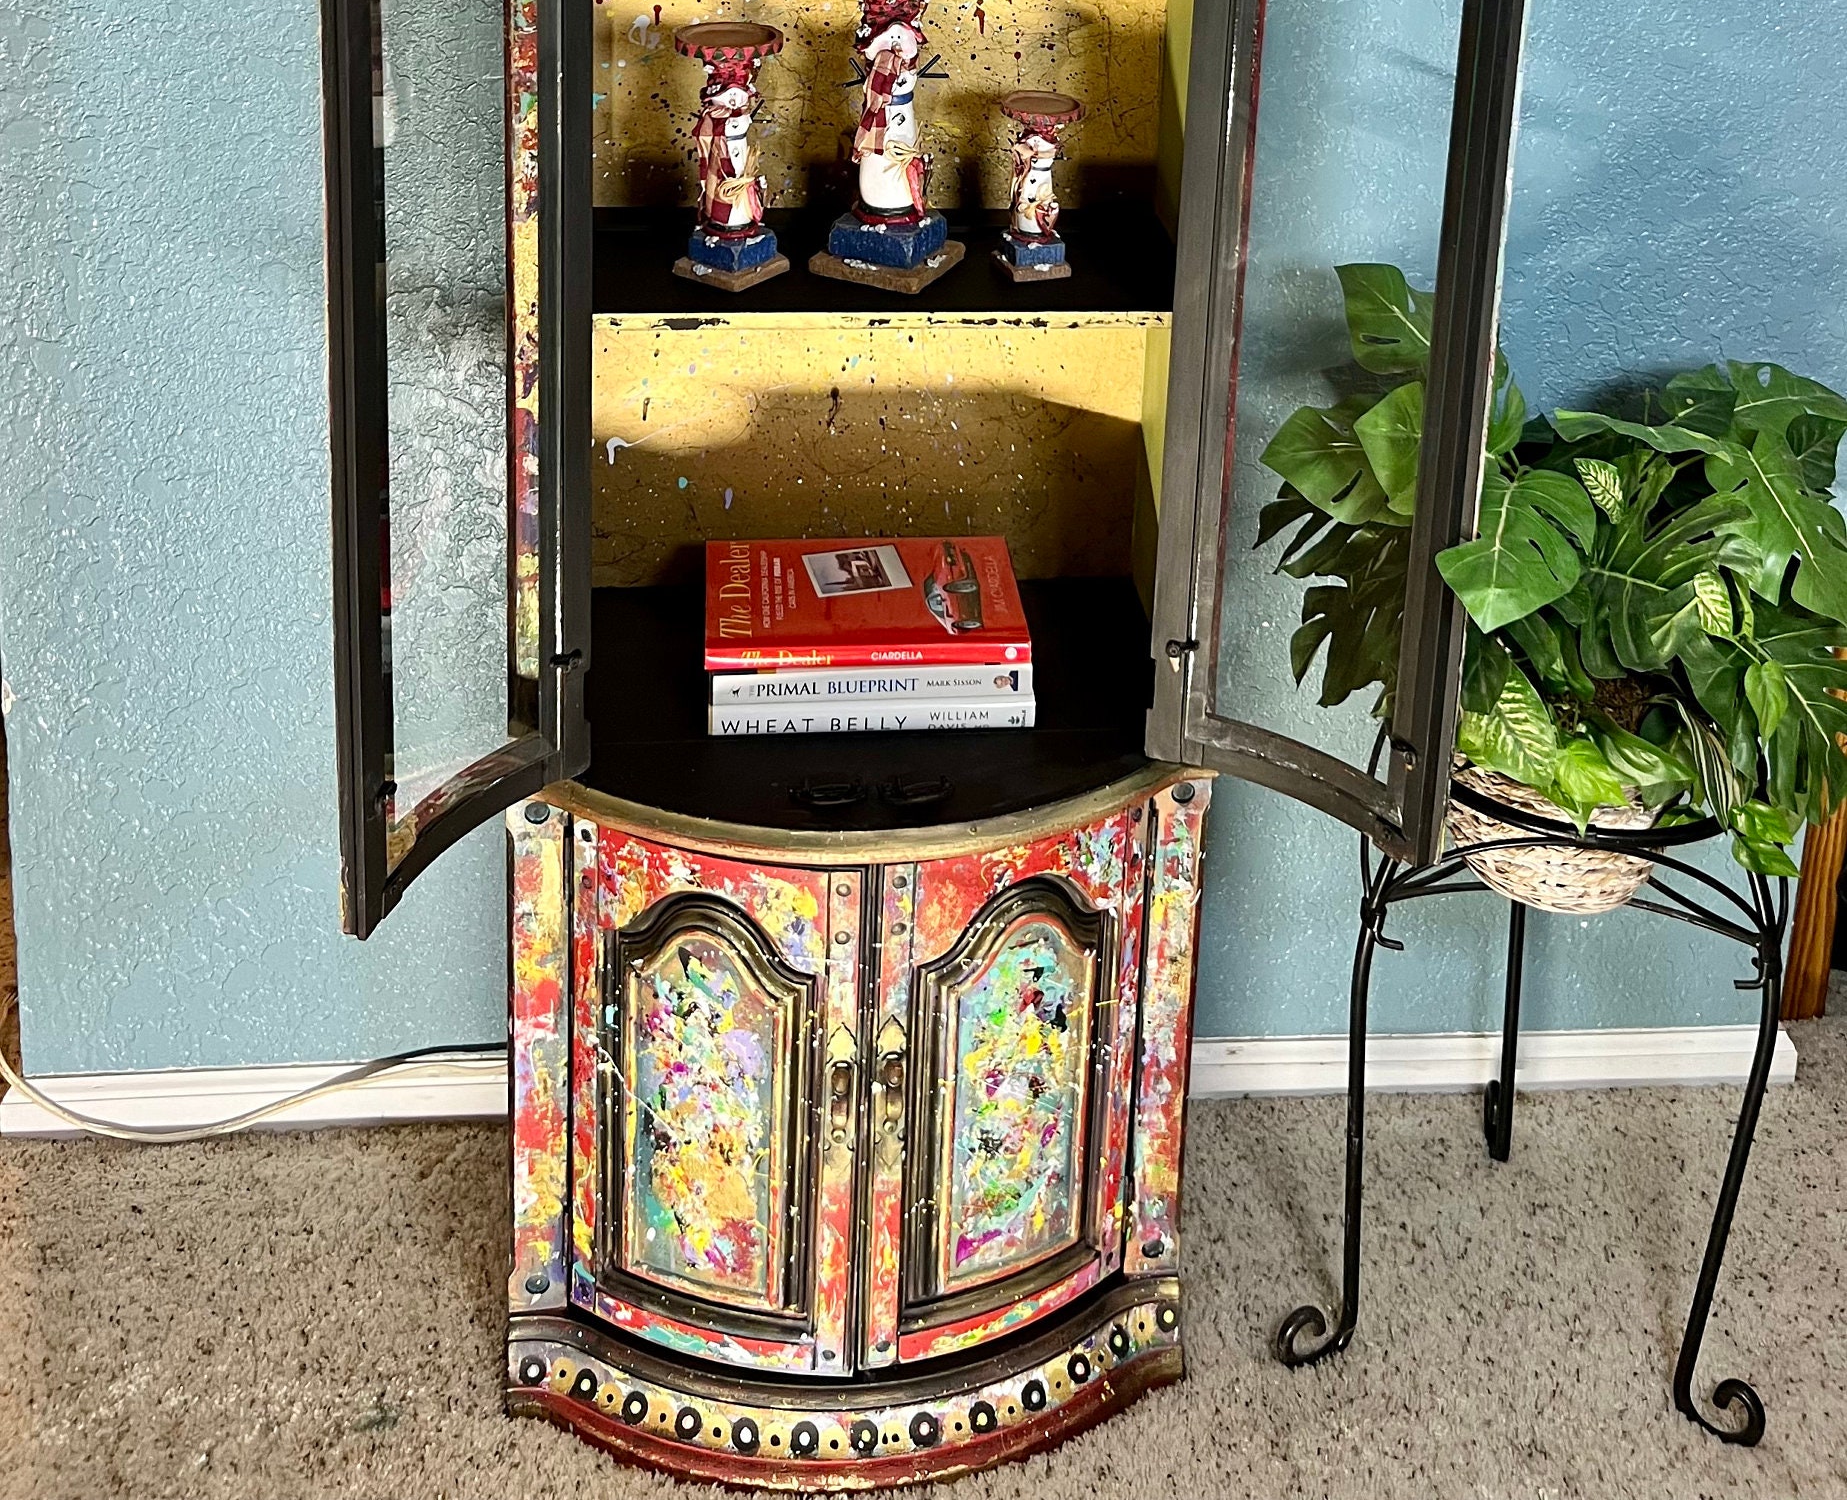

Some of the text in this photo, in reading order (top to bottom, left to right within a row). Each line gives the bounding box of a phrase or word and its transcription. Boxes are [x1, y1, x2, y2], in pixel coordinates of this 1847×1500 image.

[786, 568, 795, 589] AMERICA
[719, 541, 752, 639] The Dealer
[761, 577, 770, 605] CALIFORNIA
[762, 604, 770, 616] ONE
[788, 595, 797, 609] CARS
[763, 616, 771, 628] HOW
[740, 649, 834, 667] The Dealer
[870, 651, 923, 662] CIARDELLA
[756, 681, 821, 698] PRIMAL
[827, 678, 919, 695] BLUEPRINT
[721, 715, 907, 734] WHEAT BELLY
[929, 710, 989, 722] WILLIAM
